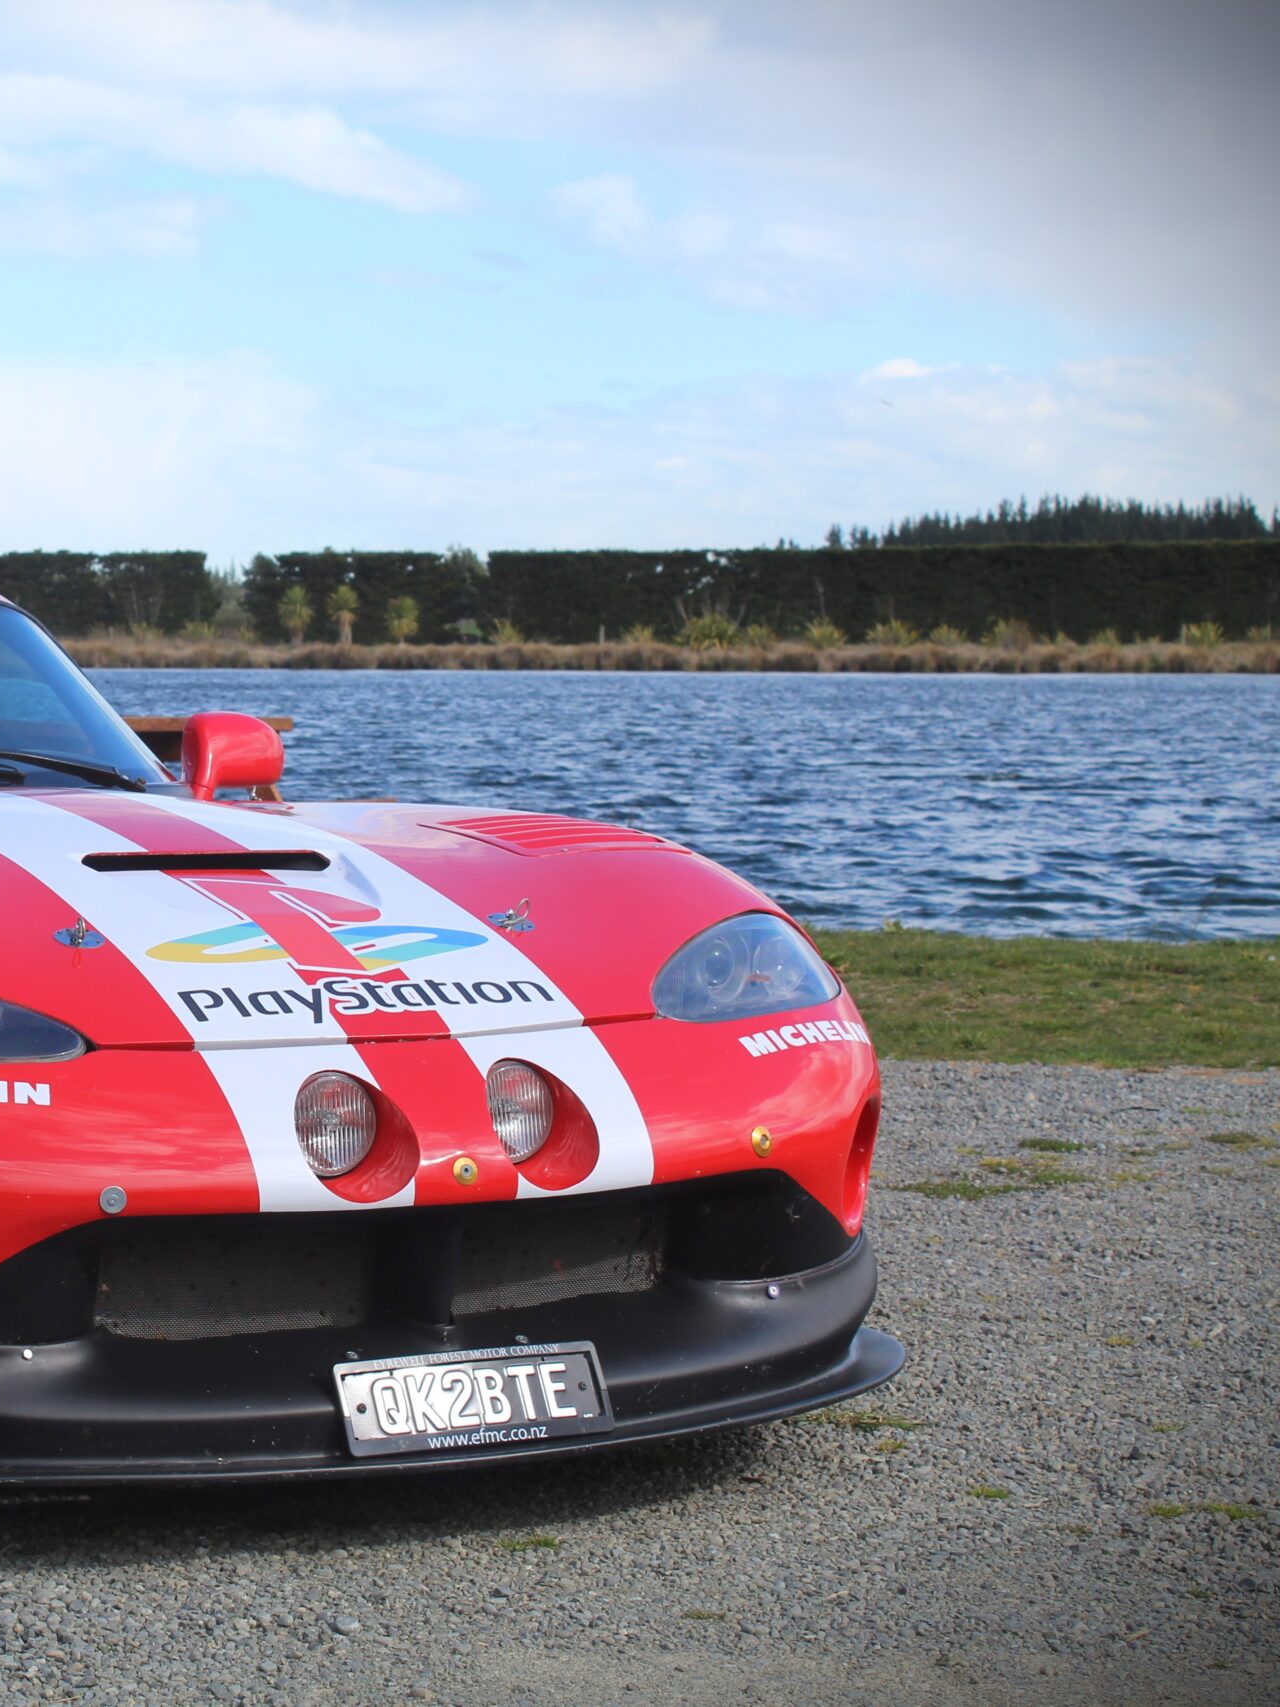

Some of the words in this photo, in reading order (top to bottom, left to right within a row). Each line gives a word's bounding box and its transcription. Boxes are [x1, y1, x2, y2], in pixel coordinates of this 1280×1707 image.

[177, 979, 554, 1024] PlayStation
[738, 1020, 871, 1057] MICHELIN
[429, 1350, 470, 1364] FOREST
[470, 1346, 507, 1360] MOTOR
[509, 1343, 560, 1356] COMPANY
[371, 1363, 577, 1435] QK2BTE
[428, 1425, 548, 1449] www.efmc.co.nz
